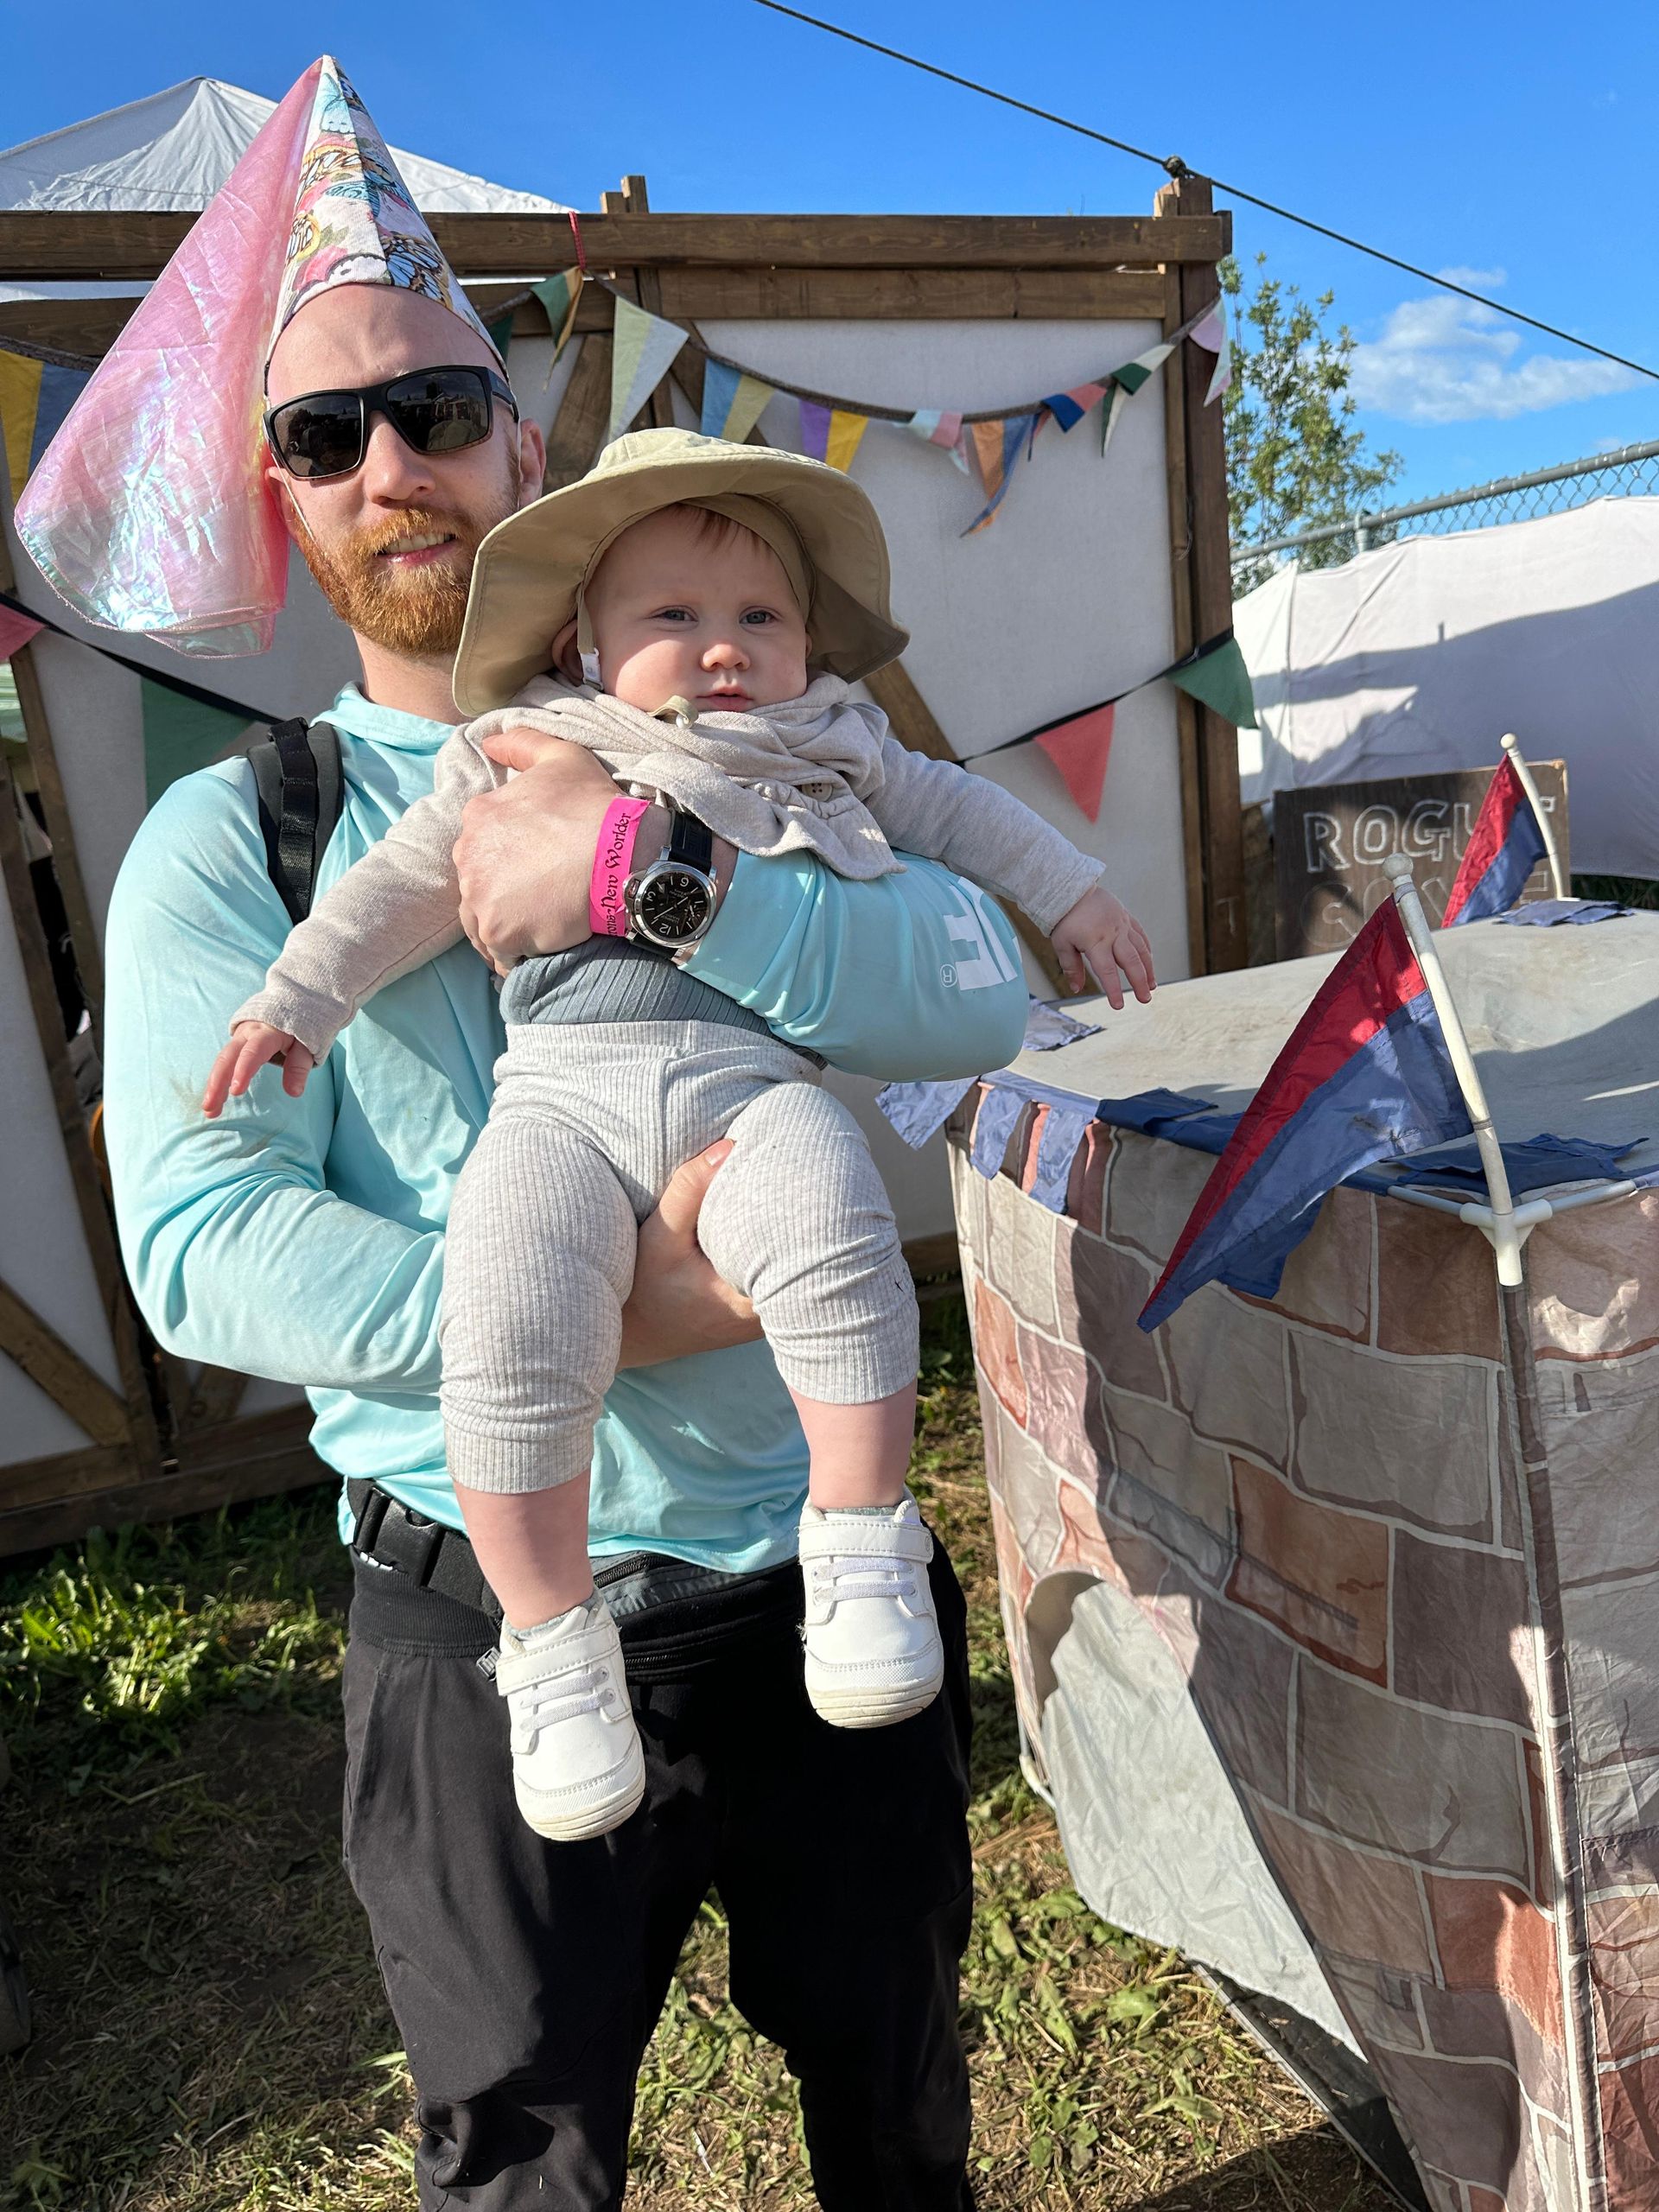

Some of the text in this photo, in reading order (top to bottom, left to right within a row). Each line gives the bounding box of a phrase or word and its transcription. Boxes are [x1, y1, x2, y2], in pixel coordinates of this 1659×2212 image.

[606, 813, 632, 869] Worlder
[1302, 796, 1555, 874] ROG
[679, 877, 690, 887] 6
[645, 891, 657, 902] 3
[658, 923, 671, 936] 12
